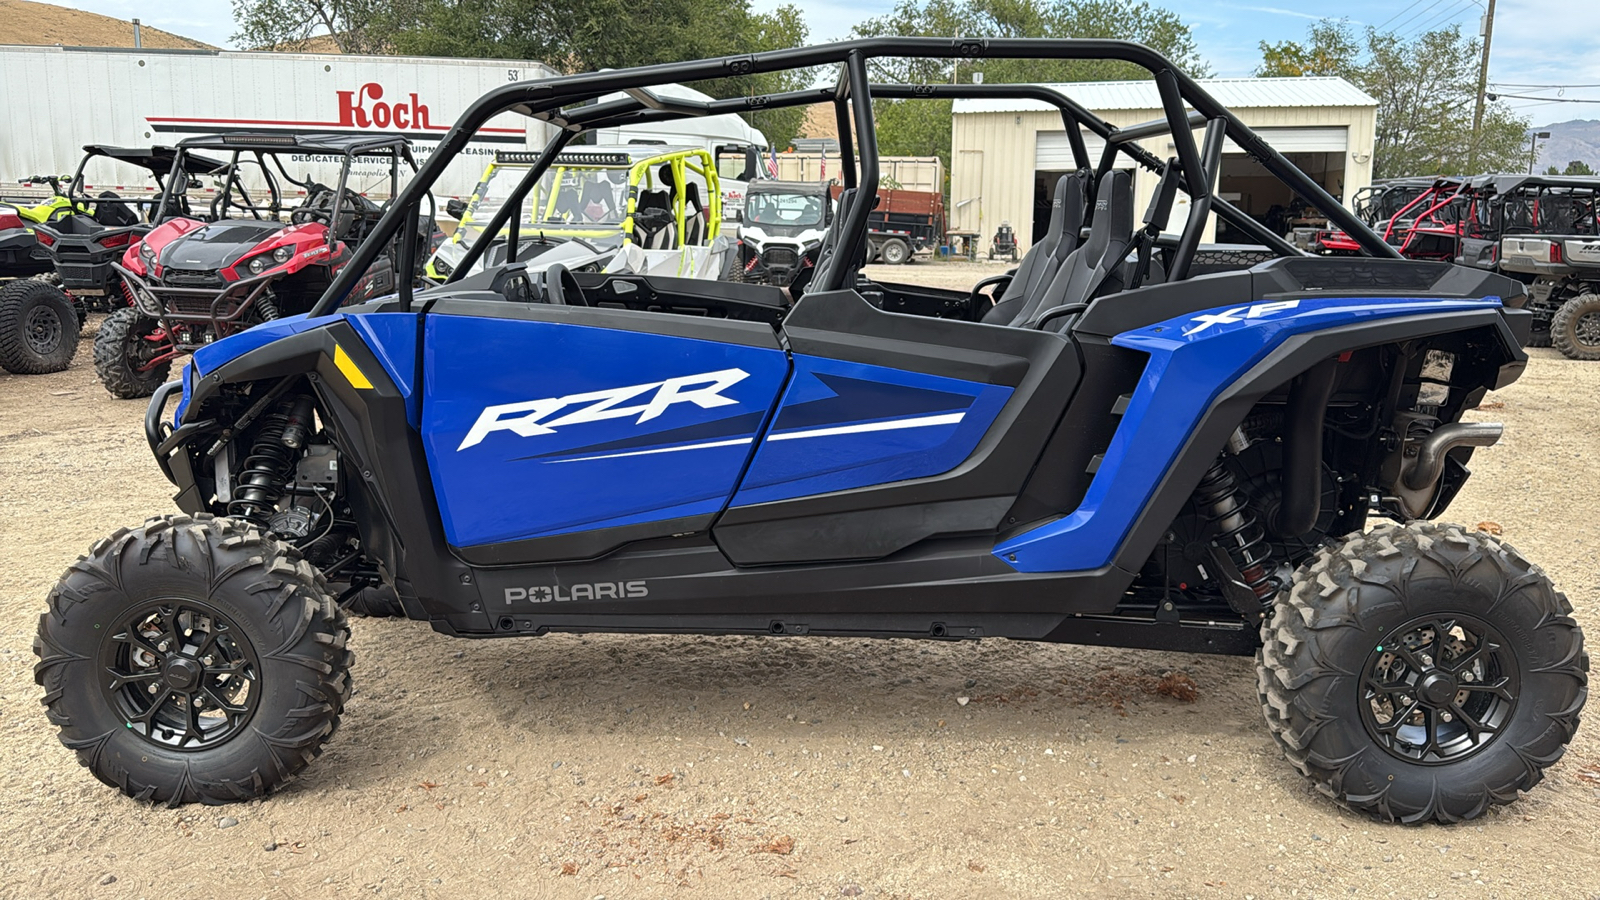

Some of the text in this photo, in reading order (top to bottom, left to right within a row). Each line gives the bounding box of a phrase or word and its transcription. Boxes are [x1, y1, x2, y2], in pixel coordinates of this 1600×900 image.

[336, 83, 430, 129] Koch
[351, 156, 392, 165] SERVICE
[1182, 300, 1300, 337] XP
[457, 368, 750, 452] RZR
[505, 581, 648, 605] POLARIS
